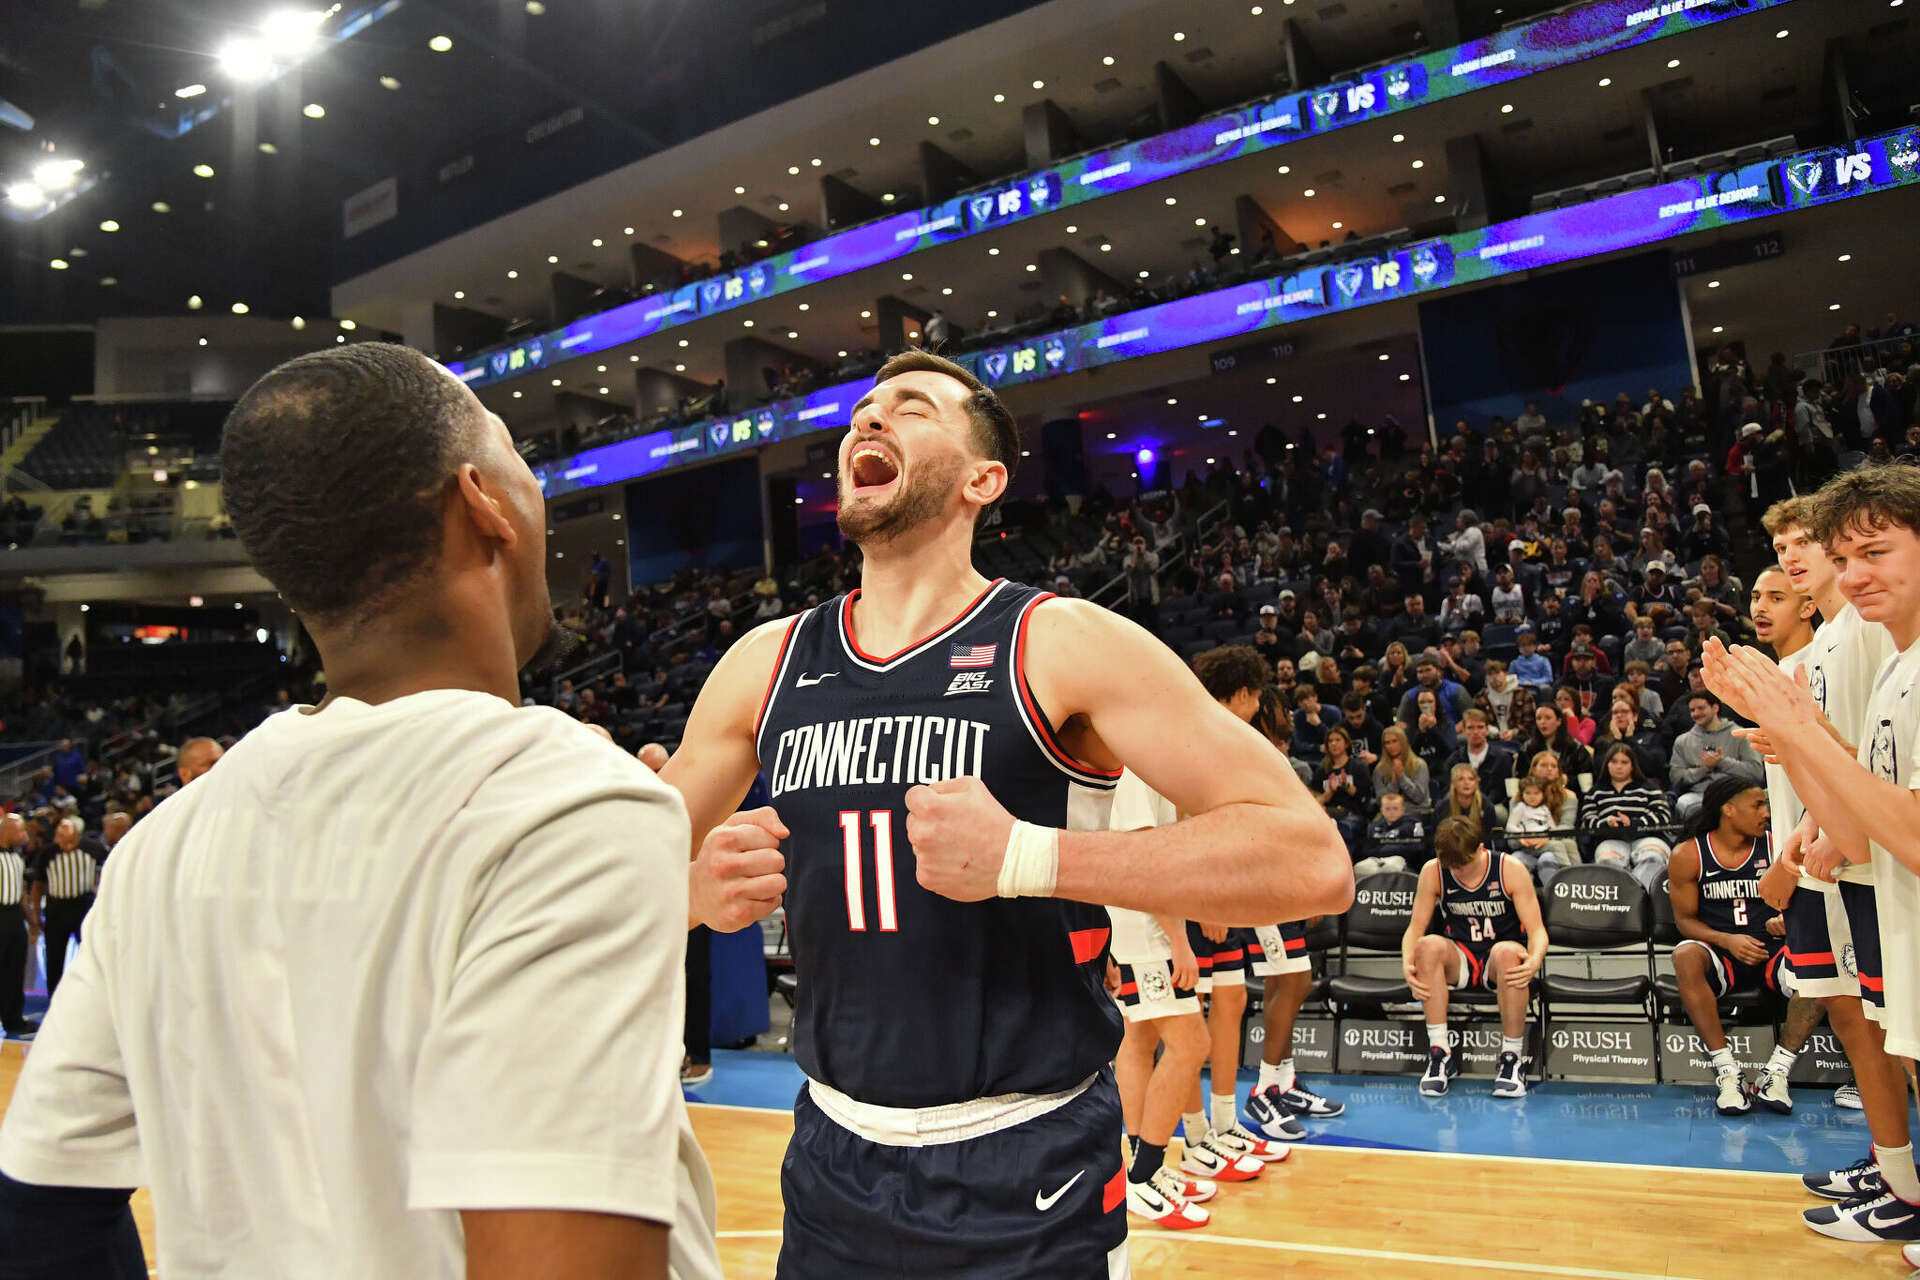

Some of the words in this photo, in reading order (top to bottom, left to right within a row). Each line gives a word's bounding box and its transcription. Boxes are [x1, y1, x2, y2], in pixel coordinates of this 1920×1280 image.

[1347, 83, 1375, 113] VS
[1836, 152, 1872, 185] VS
[999, 189, 1022, 216] VS
[1371, 260, 1401, 291] VS
[1013, 348, 1036, 374] VS
[947, 679, 994, 691] EAST
[952, 671, 987, 682] BIG
[771, 715, 991, 799] CONNECTICUT
[839, 810, 898, 932] 11
[1371, 891, 1415, 906] RUSH
[1571, 883, 1619, 900] RUSH
[1570, 902, 1600, 912] Physical
[1601, 903, 1631, 913] Therapy
[1733, 899, 1749, 926] 2
[1467, 917, 1496, 942] 24
[1362, 1029, 1414, 1047] RUSH
[1462, 1030, 1502, 1048] RUS
[1572, 1030, 1632, 1050] RUSH
[1297, 1048, 1328, 1059] Therapy
[1361, 1050, 1394, 1061] Physical
[1394, 1051, 1427, 1062] Therapy
[1462, 1052, 1497, 1062] Physical
[1572, 1054, 1610, 1064] Physical
[1611, 1054, 1648, 1066] Therapy
[1815, 1059, 1849, 1070] Physic
